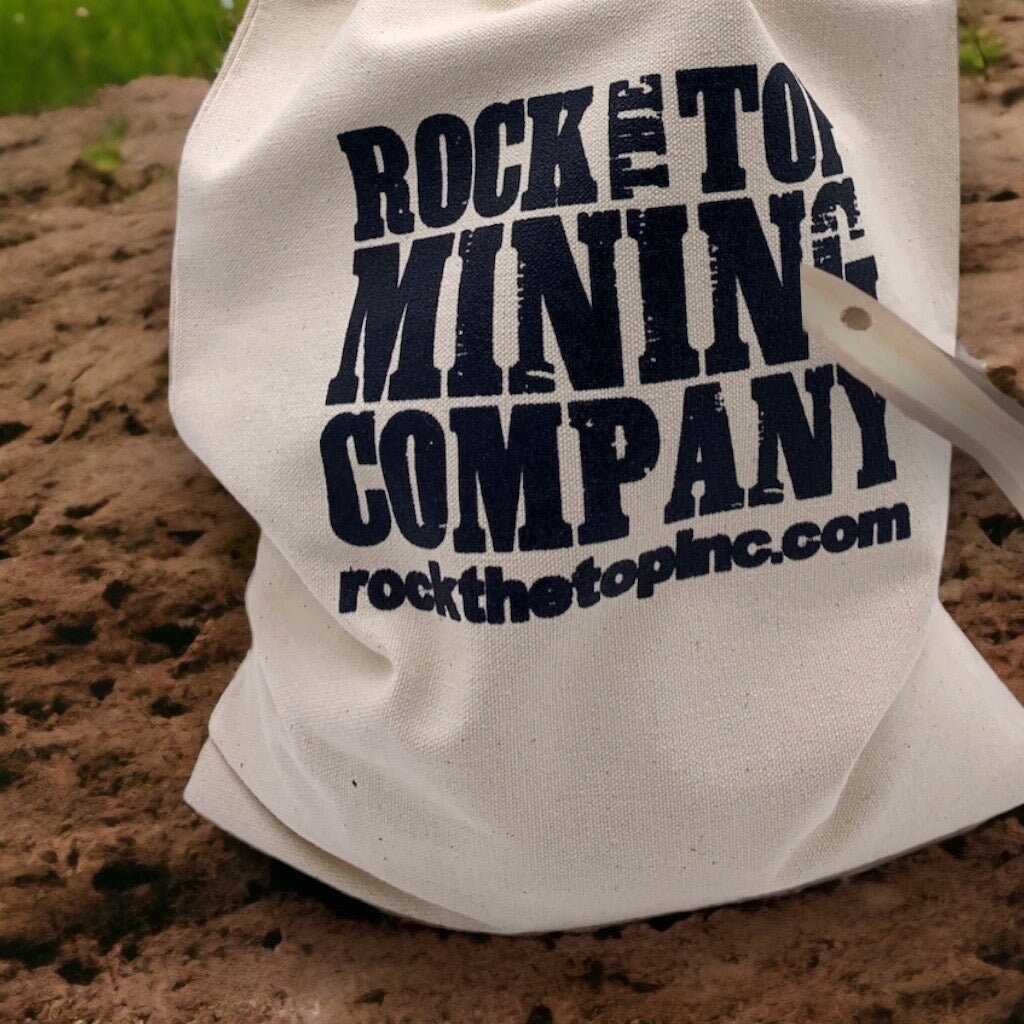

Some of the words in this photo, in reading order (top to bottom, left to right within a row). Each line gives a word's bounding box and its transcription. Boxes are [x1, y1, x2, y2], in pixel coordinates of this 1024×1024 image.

[337, 85, 598, 242] ROCK
[608, 74, 670, 200] THE
[319, 364, 897, 554] COMPANY
